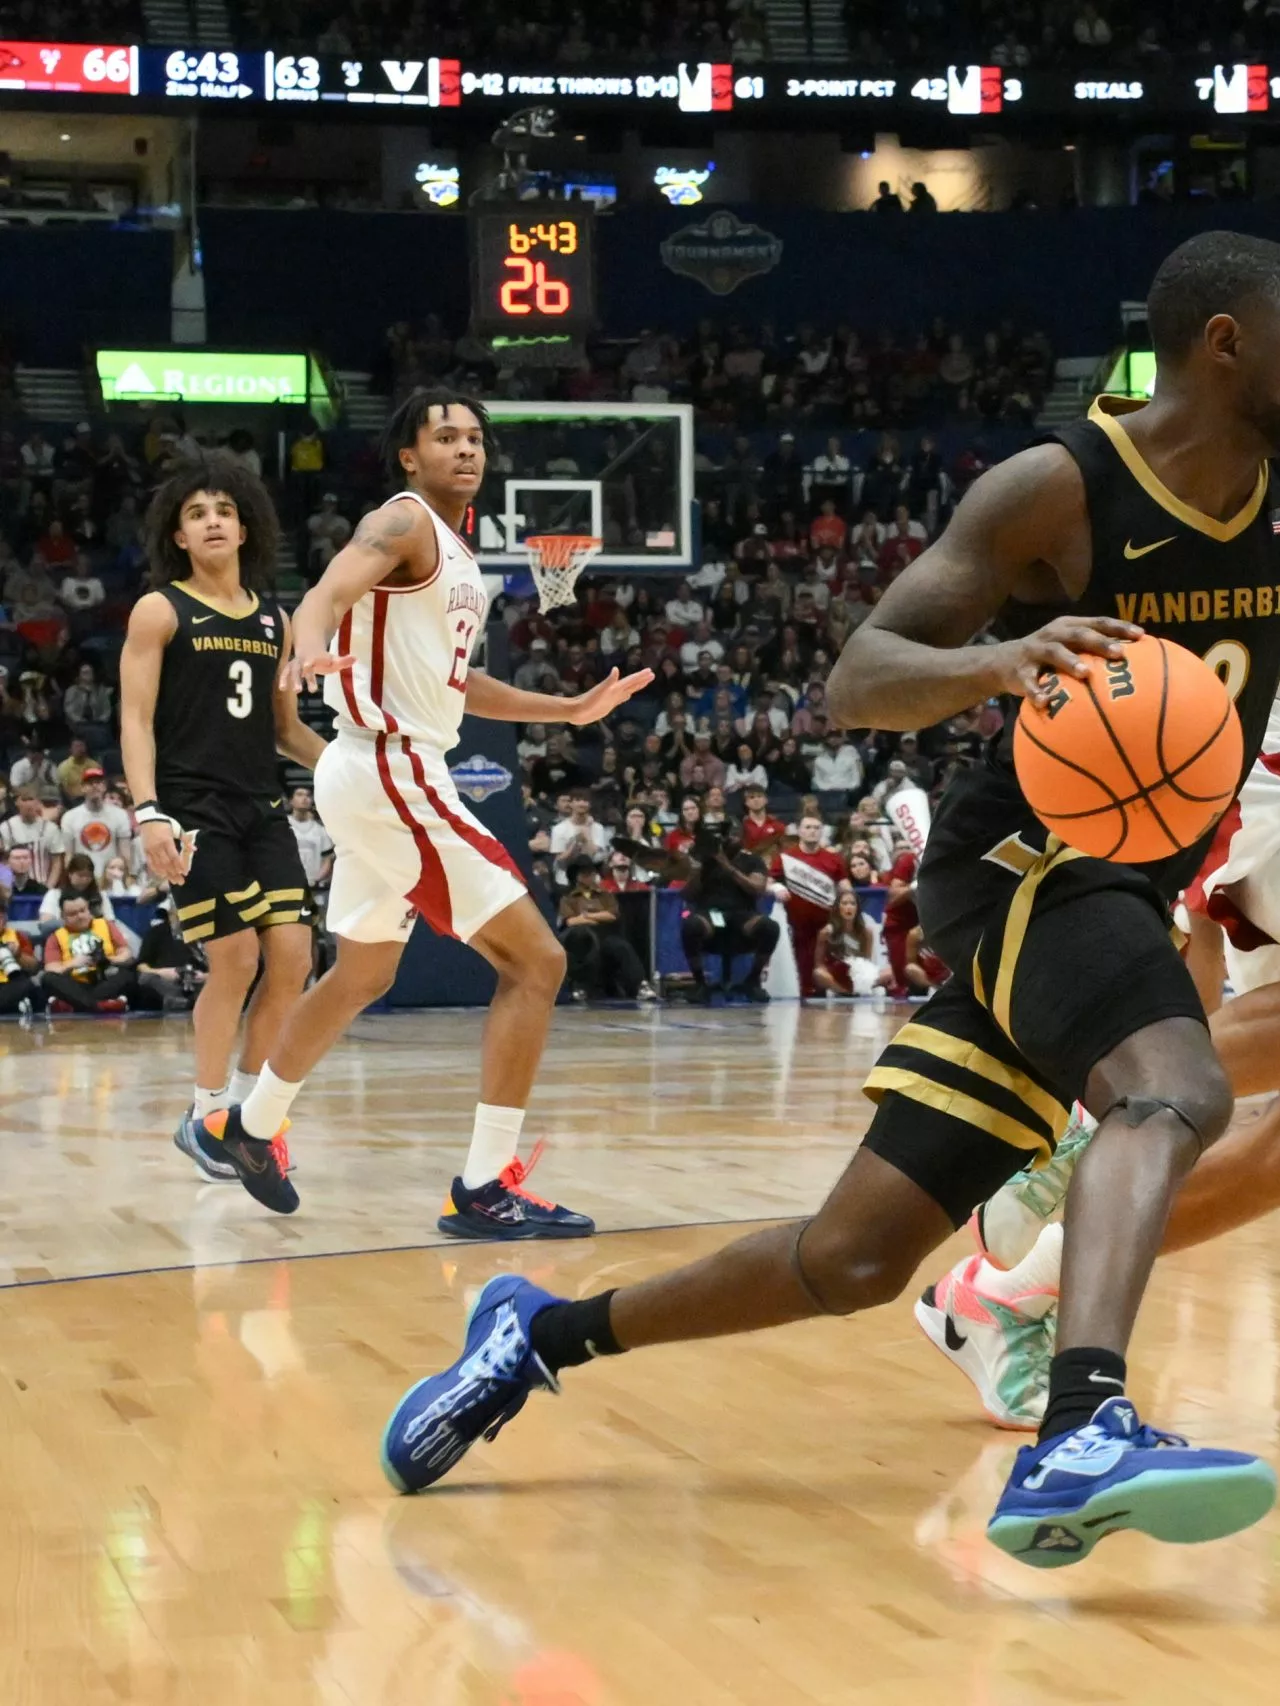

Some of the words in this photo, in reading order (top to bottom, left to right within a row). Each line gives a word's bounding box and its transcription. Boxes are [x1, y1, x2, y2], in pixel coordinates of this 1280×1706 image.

[83, 48, 130, 82] 66
[166, 50, 239, 82] 6:43
[275, 56, 320, 89] 63
[507, 76, 555, 94] FREE
[557, 76, 633, 96] THROWS
[787, 79, 858, 97] 3-POINT
[859, 79, 896, 97] PCT
[1002, 78, 1022, 101] 3
[1074, 81, 1144, 100] STEALS
[509, 221, 578, 254] 6:43
[500, 257, 570, 314] 26
[162, 369, 292, 396] REGIONS
[192, 636, 278, 659] VANDERBILT
[226, 660, 253, 719] 3
